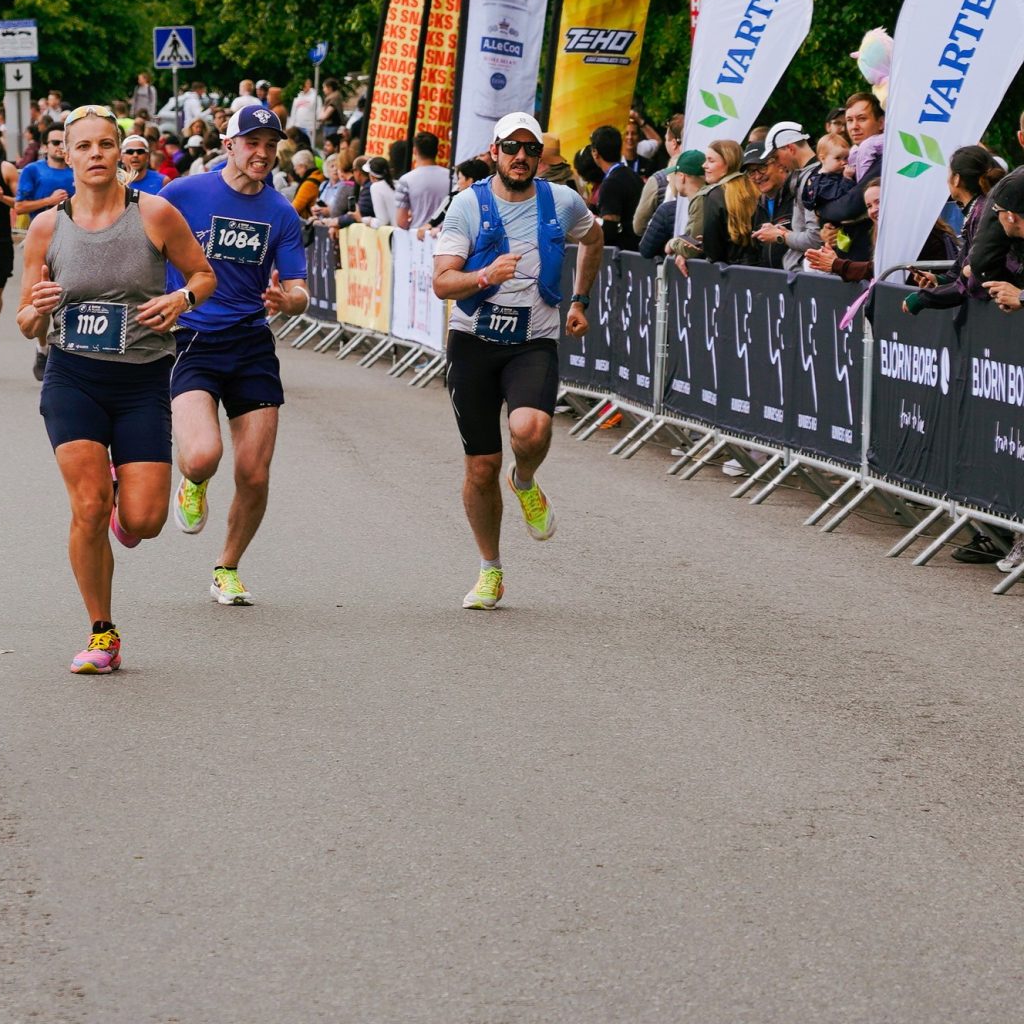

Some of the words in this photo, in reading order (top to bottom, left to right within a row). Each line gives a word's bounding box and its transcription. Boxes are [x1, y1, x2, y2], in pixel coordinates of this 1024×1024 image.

[566, 28, 635, 52] TEHO
[218, 228, 261, 252] 1084
[77, 314, 108, 335] 1110
[489, 314, 518, 334] 1171
[880, 331, 912, 382] BJÖRN
[911, 345, 938, 388] BORG
[972, 347, 1006, 404] BJÖRN
[1007, 364, 1024, 408] BO
